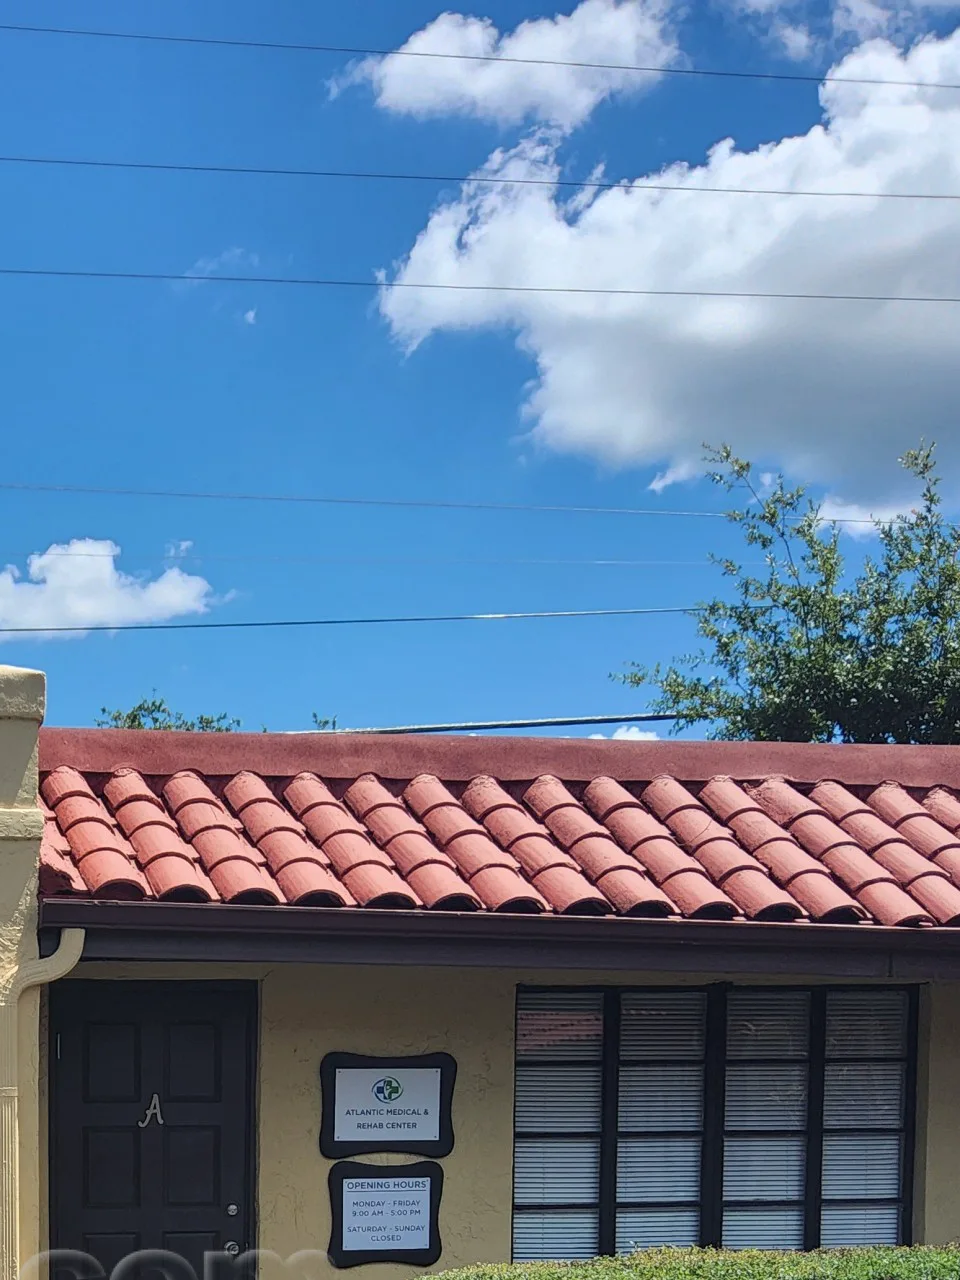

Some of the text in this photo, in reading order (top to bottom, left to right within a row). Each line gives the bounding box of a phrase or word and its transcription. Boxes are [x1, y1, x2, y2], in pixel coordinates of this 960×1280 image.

[138, 1094, 164, 1128] A
[345, 1108, 429, 1116] ATLANTIC MEDICAL &
[347, 1180, 427, 1190] OPENING HOURS
[352, 1200, 386, 1208] MONDAY
[393, 1199, 421, 1207] FRIDAY
[347, 1225, 387, 1233] SATURDAY
[370, 1234, 402, 1242] CLOSED
